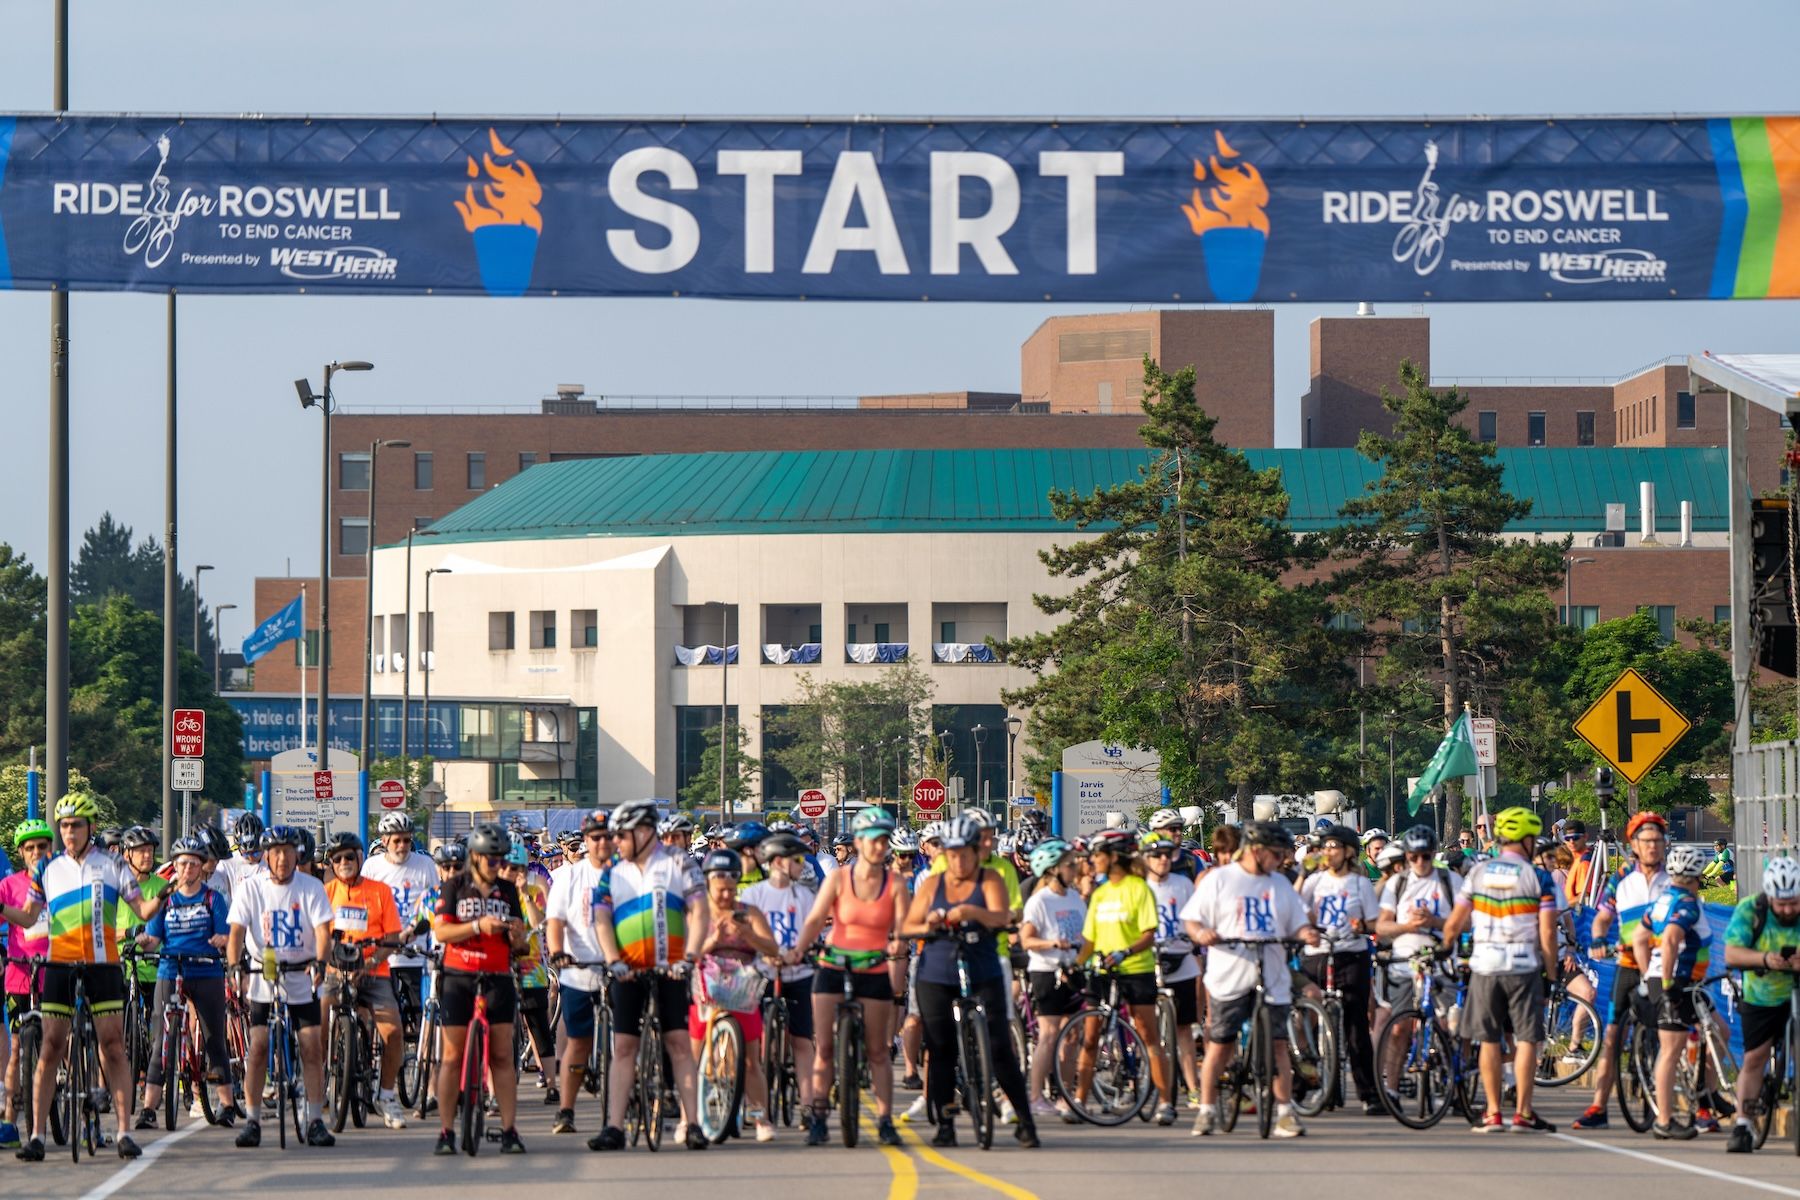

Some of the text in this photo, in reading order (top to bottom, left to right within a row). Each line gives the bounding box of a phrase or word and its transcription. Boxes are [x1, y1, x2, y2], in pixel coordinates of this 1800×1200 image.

[53, 182, 400, 230] RIDE for ROSWELL
[606, 146, 1125, 274] START
[1323, 189, 1669, 237] RIDE for ROSWELL
[219, 224, 352, 240] TO END CANCER
[1487, 228, 1621, 243] TO END CANCER
[181, 253, 261, 267] Presented by
[1451, 259, 1531, 272] Presented by
[253, 708, 283, 725] take
[286, 713, 295, 725] a
[298, 708, 338, 726] brek
[175, 735, 202, 744] WRONG
[1476, 738, 1488, 746] IKE
[180, 744, 196, 753] WAY
[180, 762, 194, 770] RIDE
[175, 779, 200, 787] TRAFFIC
[915, 788, 944, 801] STOP
